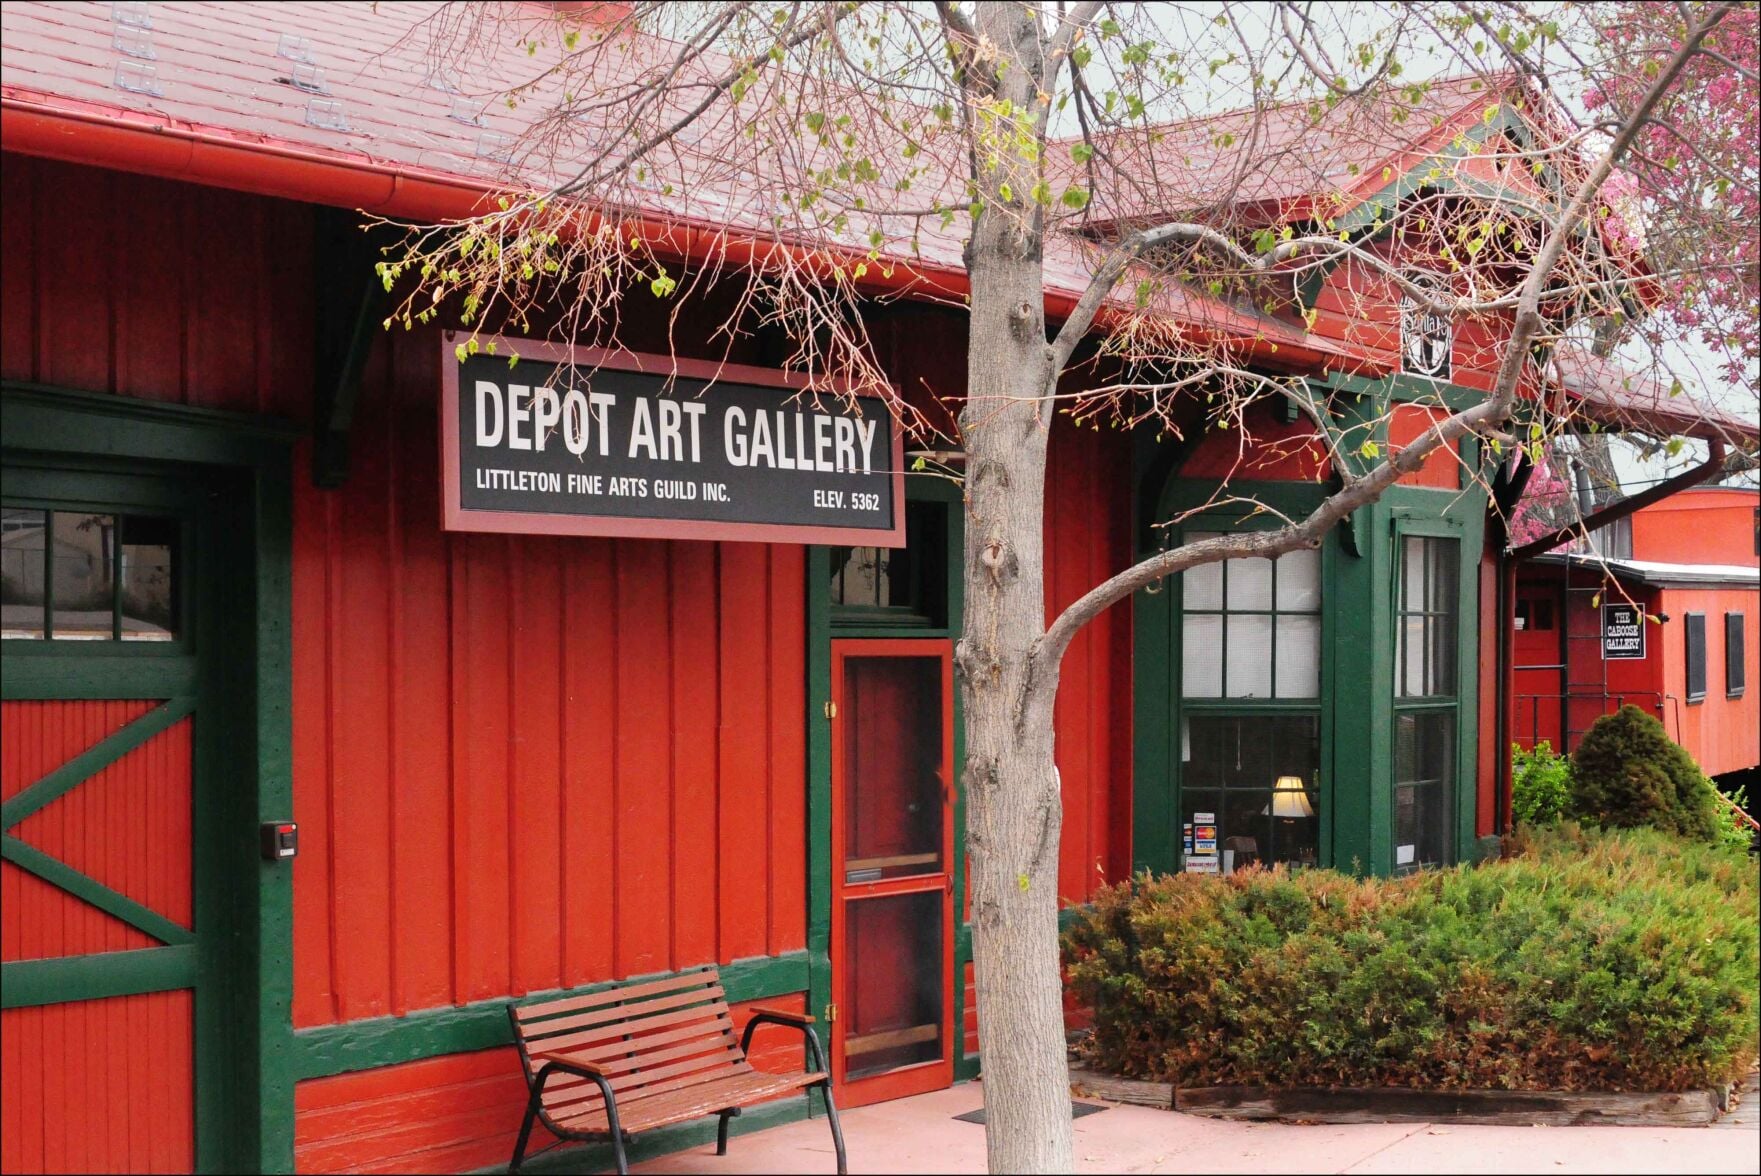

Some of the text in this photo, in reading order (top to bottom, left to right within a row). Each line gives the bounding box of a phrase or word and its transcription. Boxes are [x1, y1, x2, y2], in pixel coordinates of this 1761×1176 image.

[475, 380, 876, 475] DEPOT ART GALLERY
[476, 468, 731, 502] LITTLETON FINE ARTS GUILD INC.
[813, 489, 880, 511] ELEV. 5362
[1615, 612, 1630, 623] THE
[1607, 625, 1638, 637] CABOOSE
[1606, 638, 1639, 650] GALLERY
